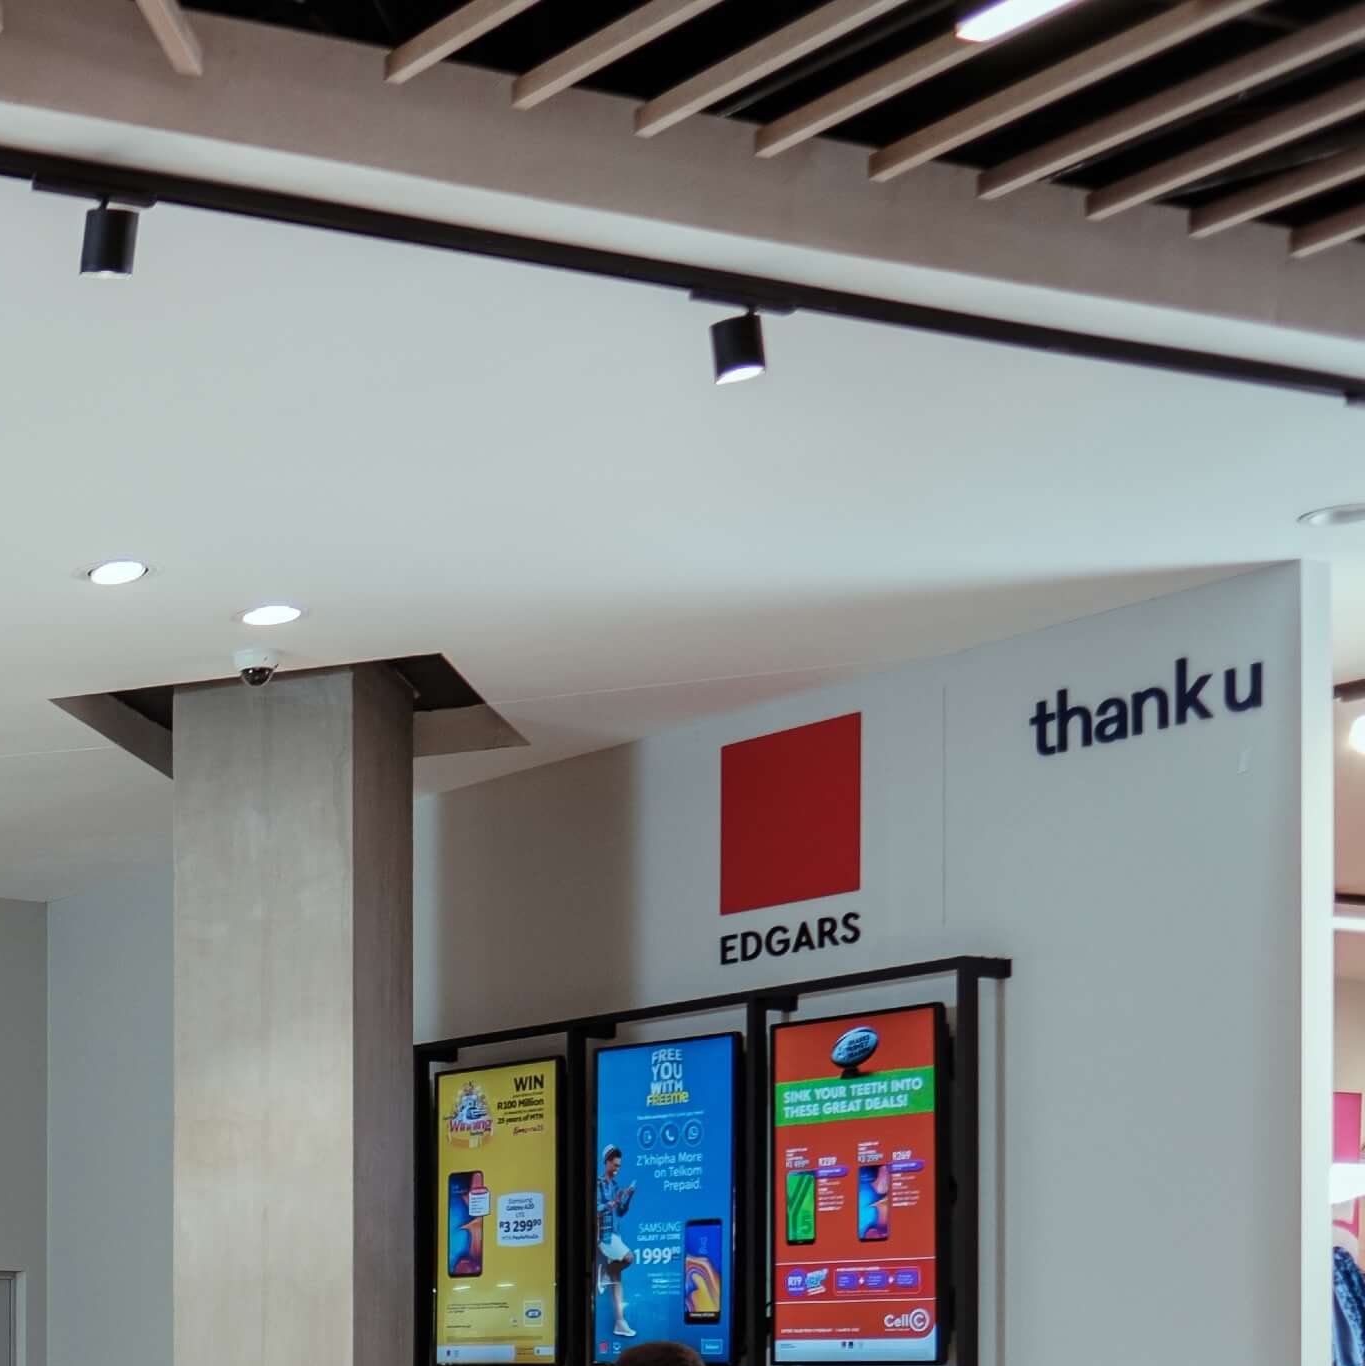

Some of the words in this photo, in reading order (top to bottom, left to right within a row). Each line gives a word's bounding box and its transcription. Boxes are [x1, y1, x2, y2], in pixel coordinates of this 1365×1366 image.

[1030, 657, 1213, 757] thank
[1223, 661, 1264, 712] u
[720, 911, 861, 967] EDGARS
[651, 1048, 683, 1064] FREE
[651, 1062, 683, 1081] YOU
[513, 1074, 544, 1092] WIN
[650, 1079, 683, 1095] WITH
[783, 1088, 811, 1104] SINK
[814, 1085, 846, 1100] YOUR
[849, 1081, 886, 1097] TEETH
[891, 1077, 923, 1093] INTO
[784, 1104, 819, 1119] THESE
[822, 1100, 862, 1114] GREAT
[864, 1094, 908, 1110] DEALS!
[678, 1152, 702, 1163] More
[654, 1168, 666, 1178] on
[668, 1166, 702, 1177] Telkom
[638, 1221, 681, 1233] SAMSUNG
